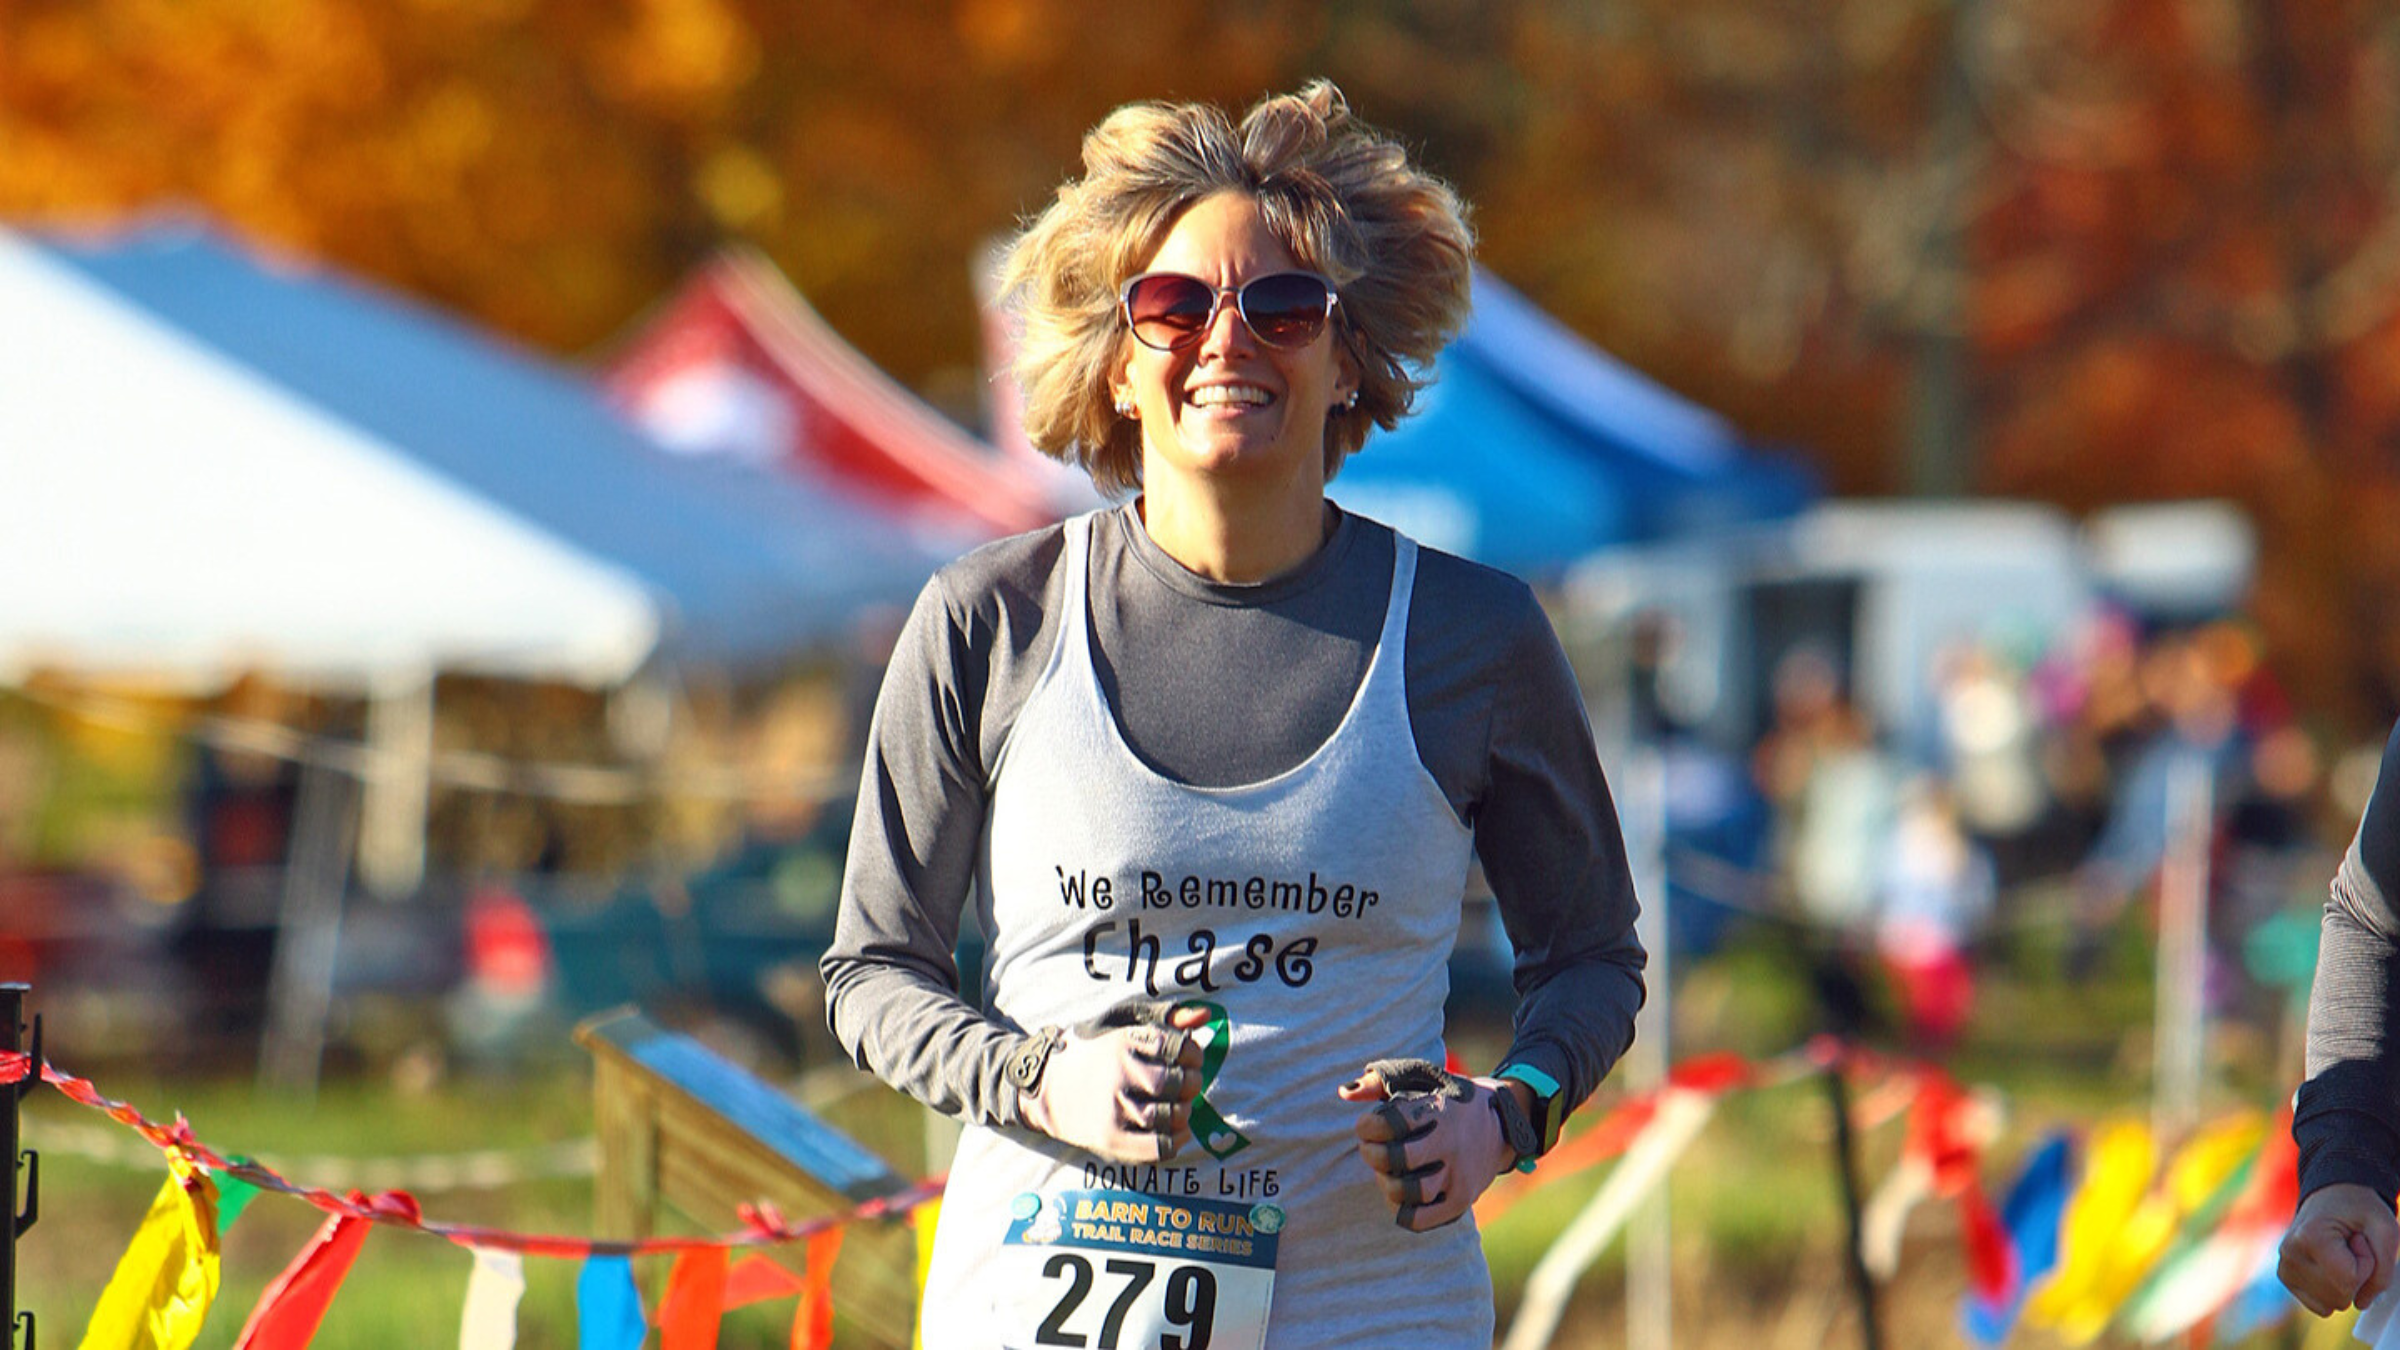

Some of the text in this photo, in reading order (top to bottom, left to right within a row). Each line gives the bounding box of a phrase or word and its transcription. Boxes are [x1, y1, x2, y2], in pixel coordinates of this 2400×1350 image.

[1056, 865, 1379, 918] We Remember
[1084, 918, 1318, 997] Chase
[1084, 1162, 1280, 1198] DONATE LIFE
[1071, 1223, 1253, 1256] TRAIL RACE SERIES
[1075, 1200, 1254, 1236] BARN TO RUN
[1035, 1253, 1217, 1350] 279
